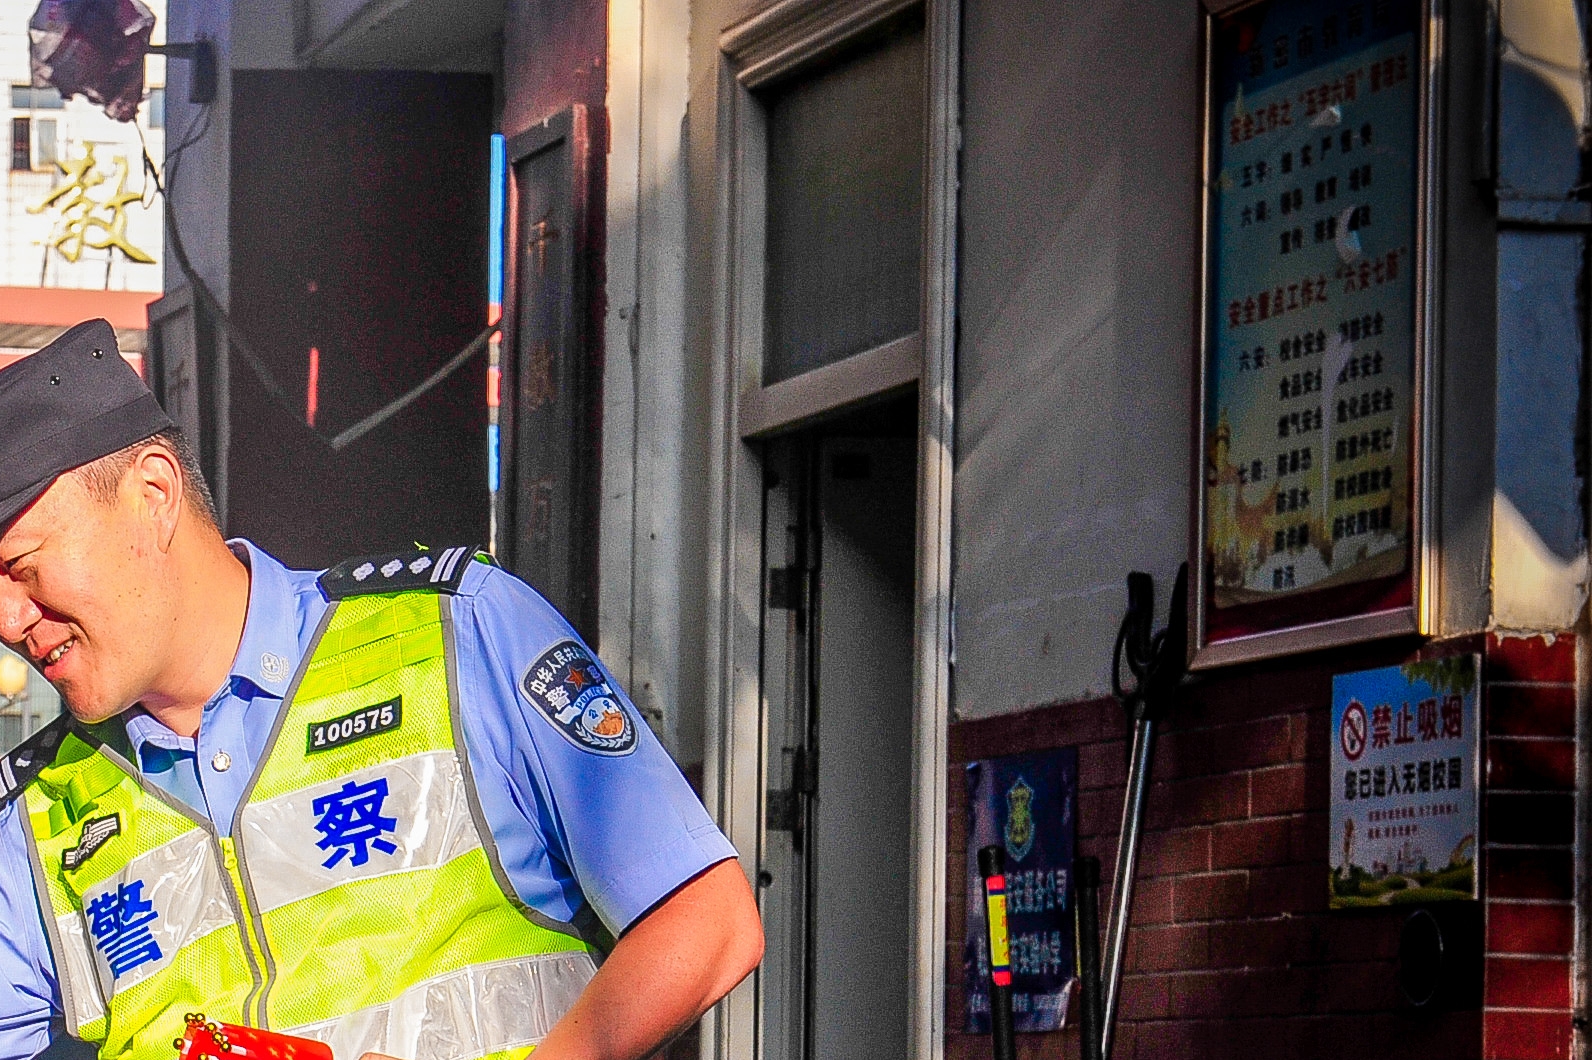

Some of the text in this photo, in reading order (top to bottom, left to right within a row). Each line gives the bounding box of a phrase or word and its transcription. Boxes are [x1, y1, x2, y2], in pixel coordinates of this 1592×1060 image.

[313, 705, 395, 747] 100575
[1372, 695, 1463, 749] 禁止吸烟
[1345, 757, 1462, 801] 您已进入无烟校园
[86, 777, 399, 980] 警 察
